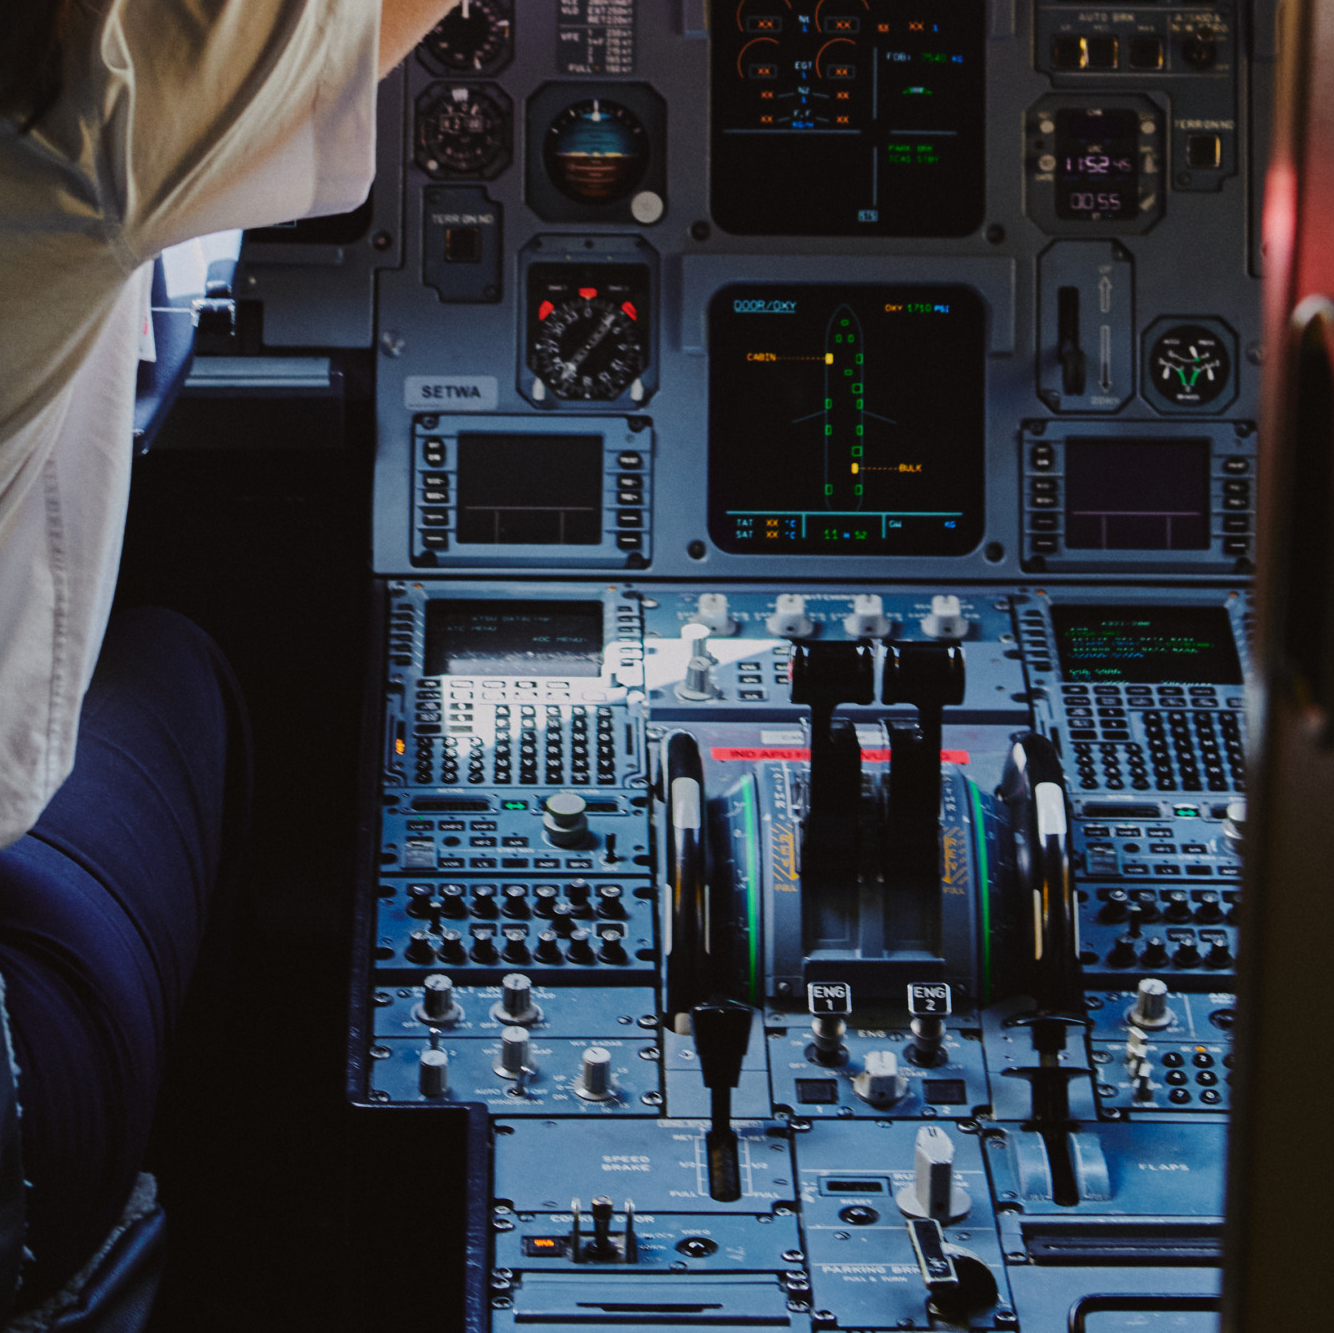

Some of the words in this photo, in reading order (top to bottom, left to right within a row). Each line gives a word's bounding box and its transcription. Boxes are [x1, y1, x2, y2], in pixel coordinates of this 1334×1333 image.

[836, 20, 851, 29] XX
[734, 299, 797, 313] DOOR/OXY
[747, 352, 777, 362] CABIN
[421, 385, 481, 398] SETWA
[898, 464, 922, 473] BULK
[813, 986, 846, 999] ENG
[913, 986, 947, 999] ENG
[826, 999, 834, 1011] 1
[925, 999, 936, 1012] 2
[858, 1029, 886, 1039] ENG
[601, 1155, 651, 1164] SPEED
[601, 1163, 651, 1172] BRAKE
[1139, 1162, 1190, 1172] FLAPS
[821, 1266, 886, 1274] PARKING
